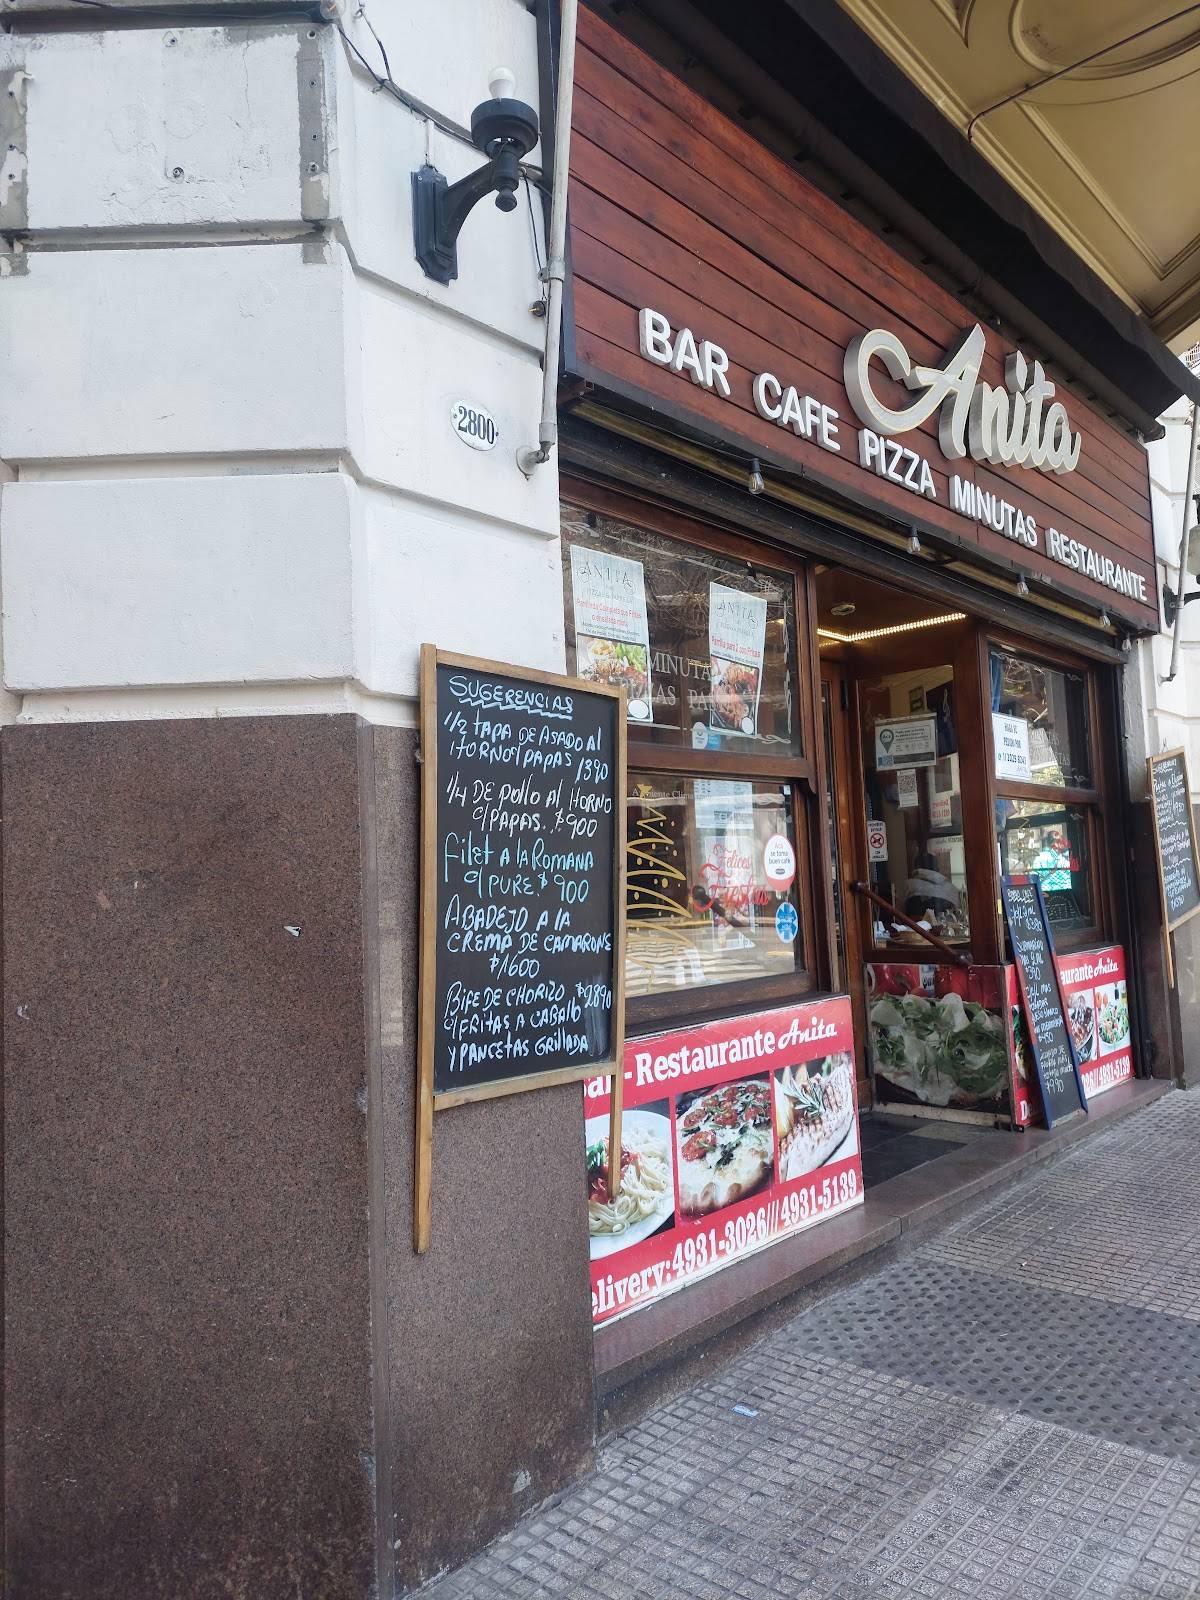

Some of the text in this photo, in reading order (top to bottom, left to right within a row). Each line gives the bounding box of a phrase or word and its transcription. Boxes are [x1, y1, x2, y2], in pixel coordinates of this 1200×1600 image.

[843, 322, 1082, 475] Anita
[458, 405, 495, 445] 2800
[639, 307, 1148, 601] BAR CAFE PIZZA MINUTAS RESTAURANTE
[444, 711, 467, 735] 1/2
[519, 727, 536, 746] DE
[539, 725, 584, 751] ASADO
[446, 771, 468, 807] 1/4
[472, 780, 495, 804] DE
[569, 782, 612, 814] HORNO
[445, 894, 529, 932] ABADEJO
[536, 910, 549, 931] A
[447, 931, 513, 953] CREMA
[518, 933, 538, 954] DE
[489, 953, 540, 980] $1600
[483, 986, 503, 1011] DE
[777, 1016, 838, 1049] Anita
